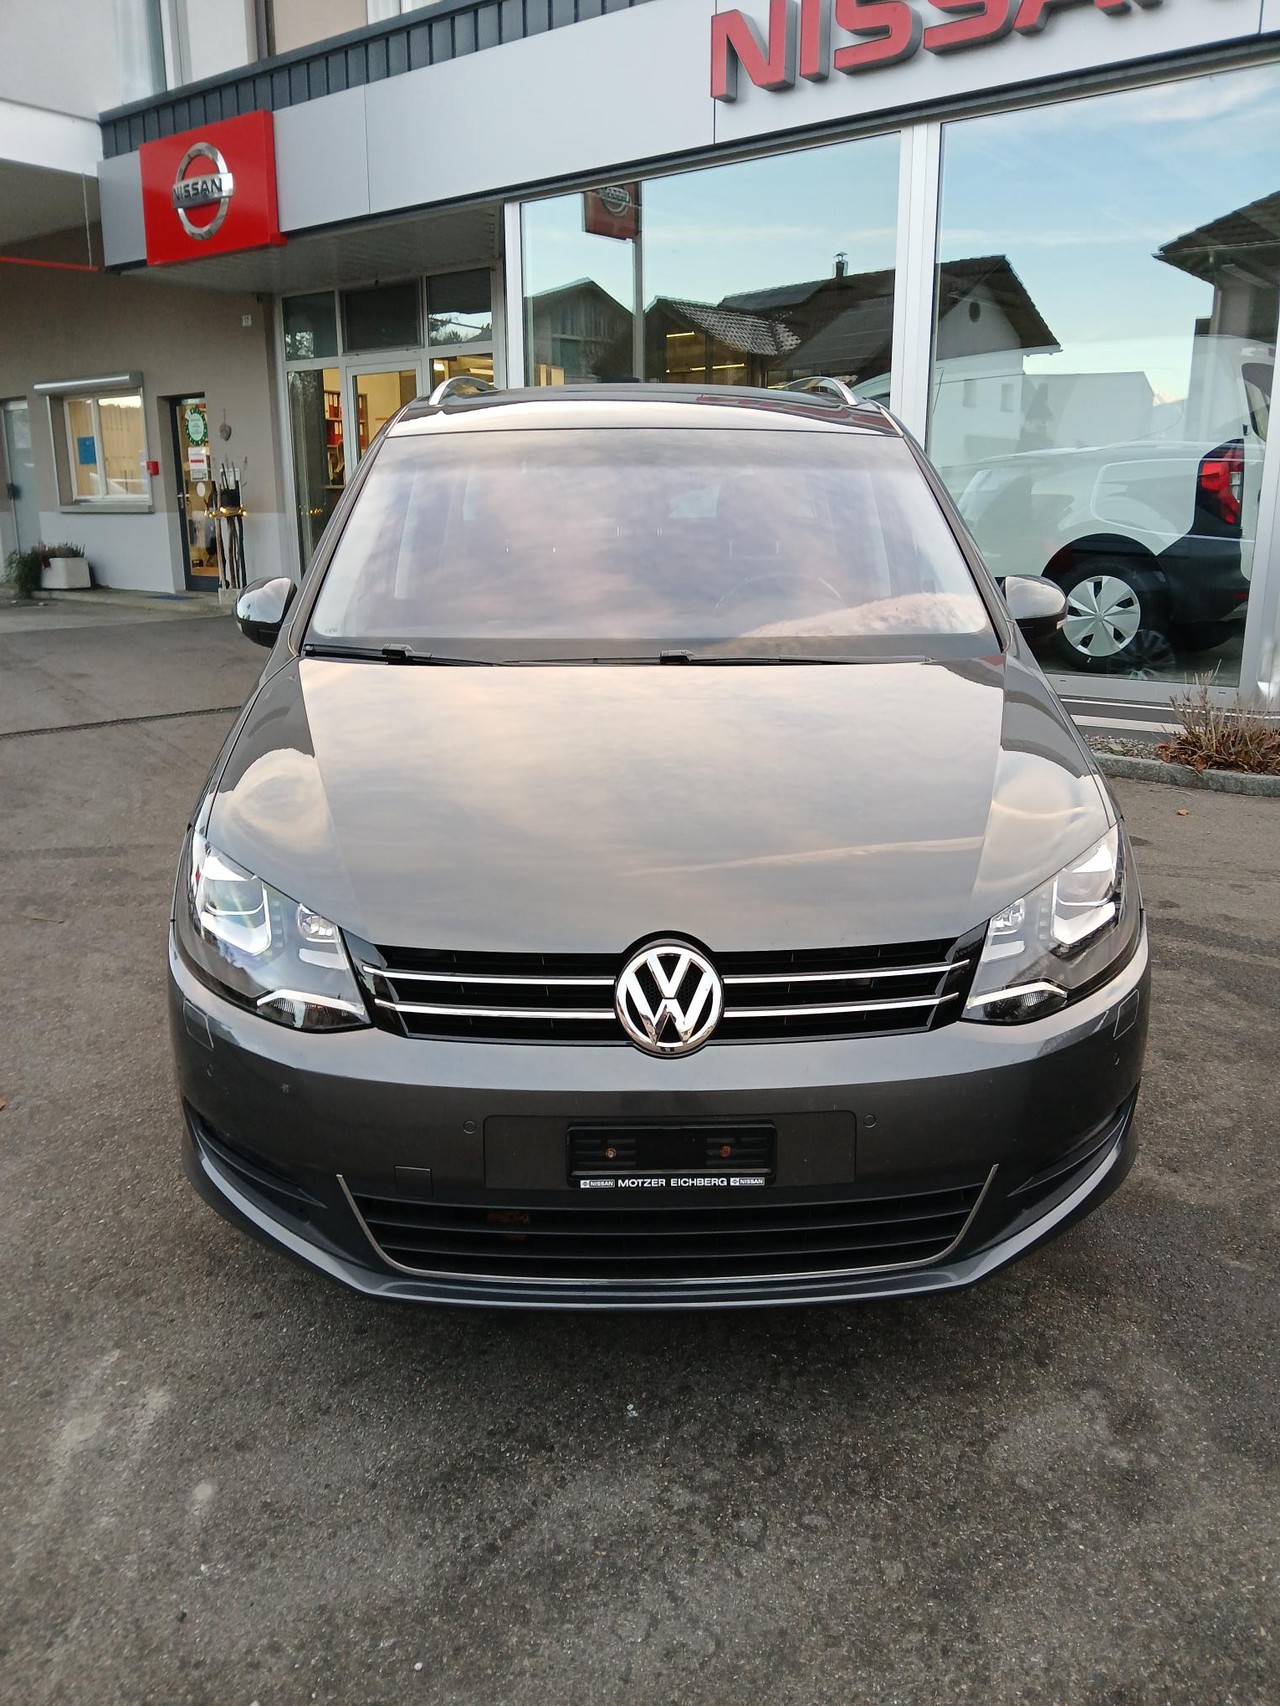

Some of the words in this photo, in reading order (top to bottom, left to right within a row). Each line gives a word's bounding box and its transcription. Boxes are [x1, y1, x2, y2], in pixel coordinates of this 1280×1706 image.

[172, 177, 223, 201] NISSAN
[617, 1178, 666, 1188] MOTZER
[670, 1177, 728, 1187] EICHBERG
